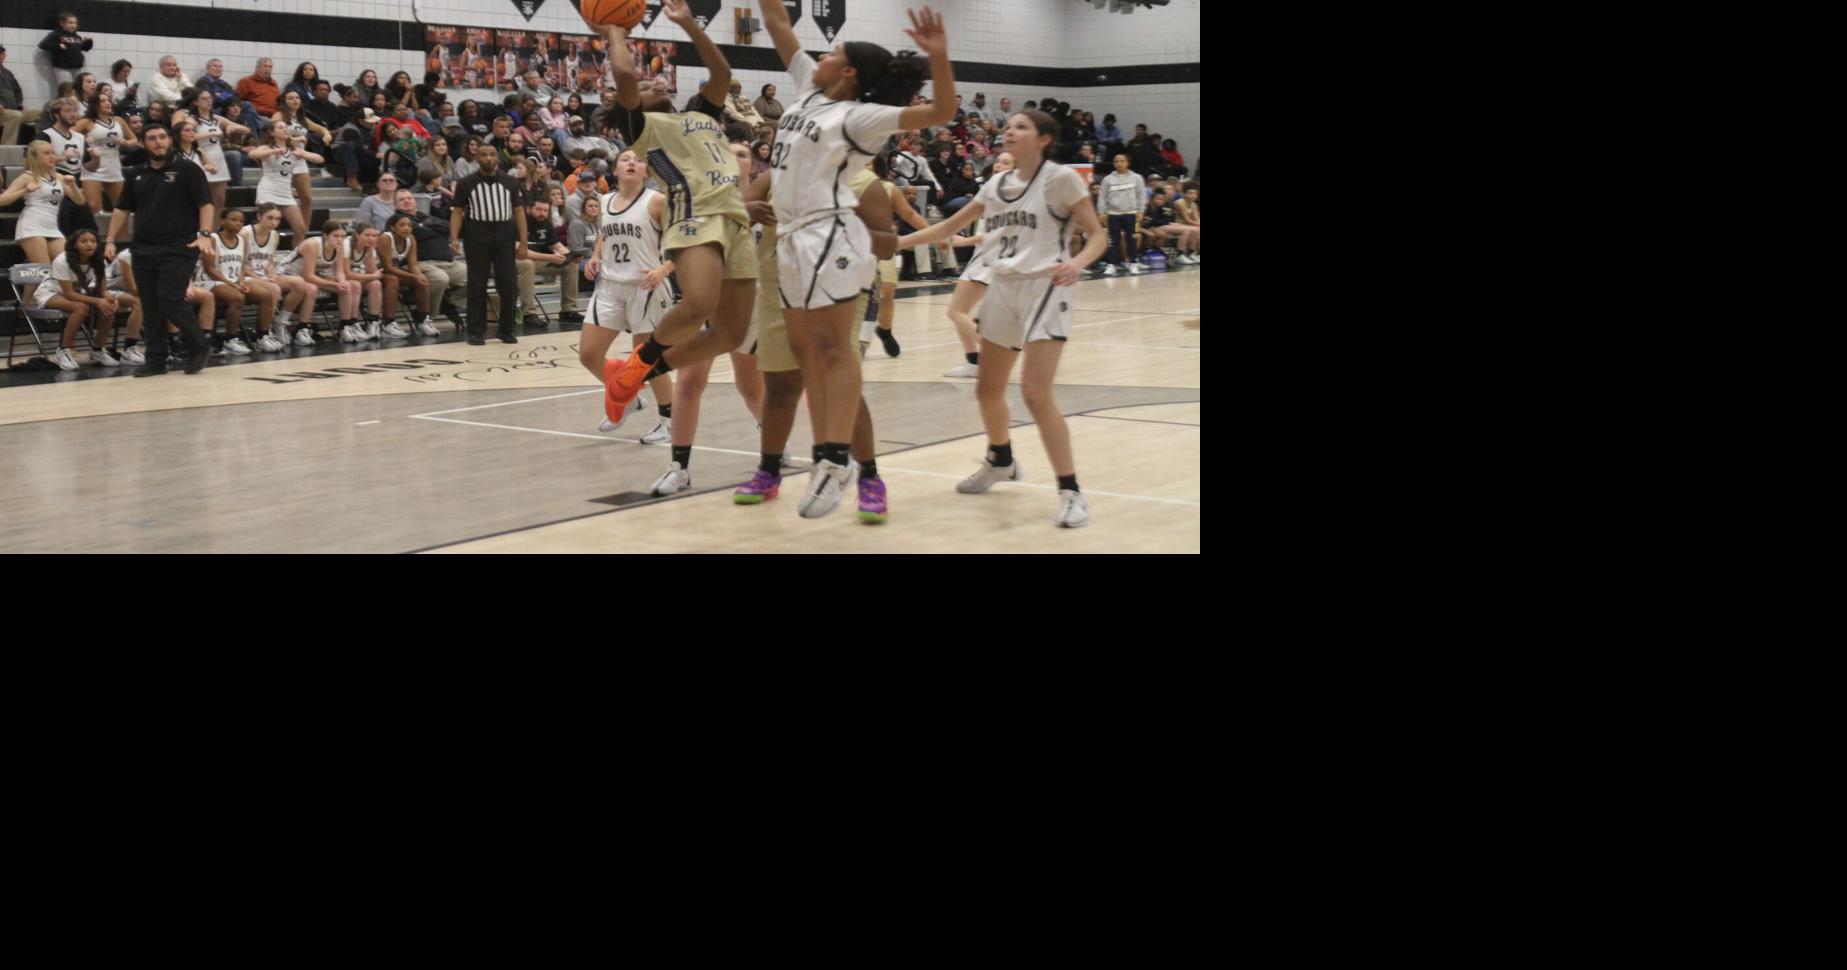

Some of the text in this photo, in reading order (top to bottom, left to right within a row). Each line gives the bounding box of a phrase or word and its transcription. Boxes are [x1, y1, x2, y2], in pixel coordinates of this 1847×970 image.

[704, 141, 727, 165] 11
[771, 142, 791, 170] 32
[601, 222, 642, 241] OUGARS
[985, 210, 1037, 234] COUGARS
[612, 243, 631, 264] 22
